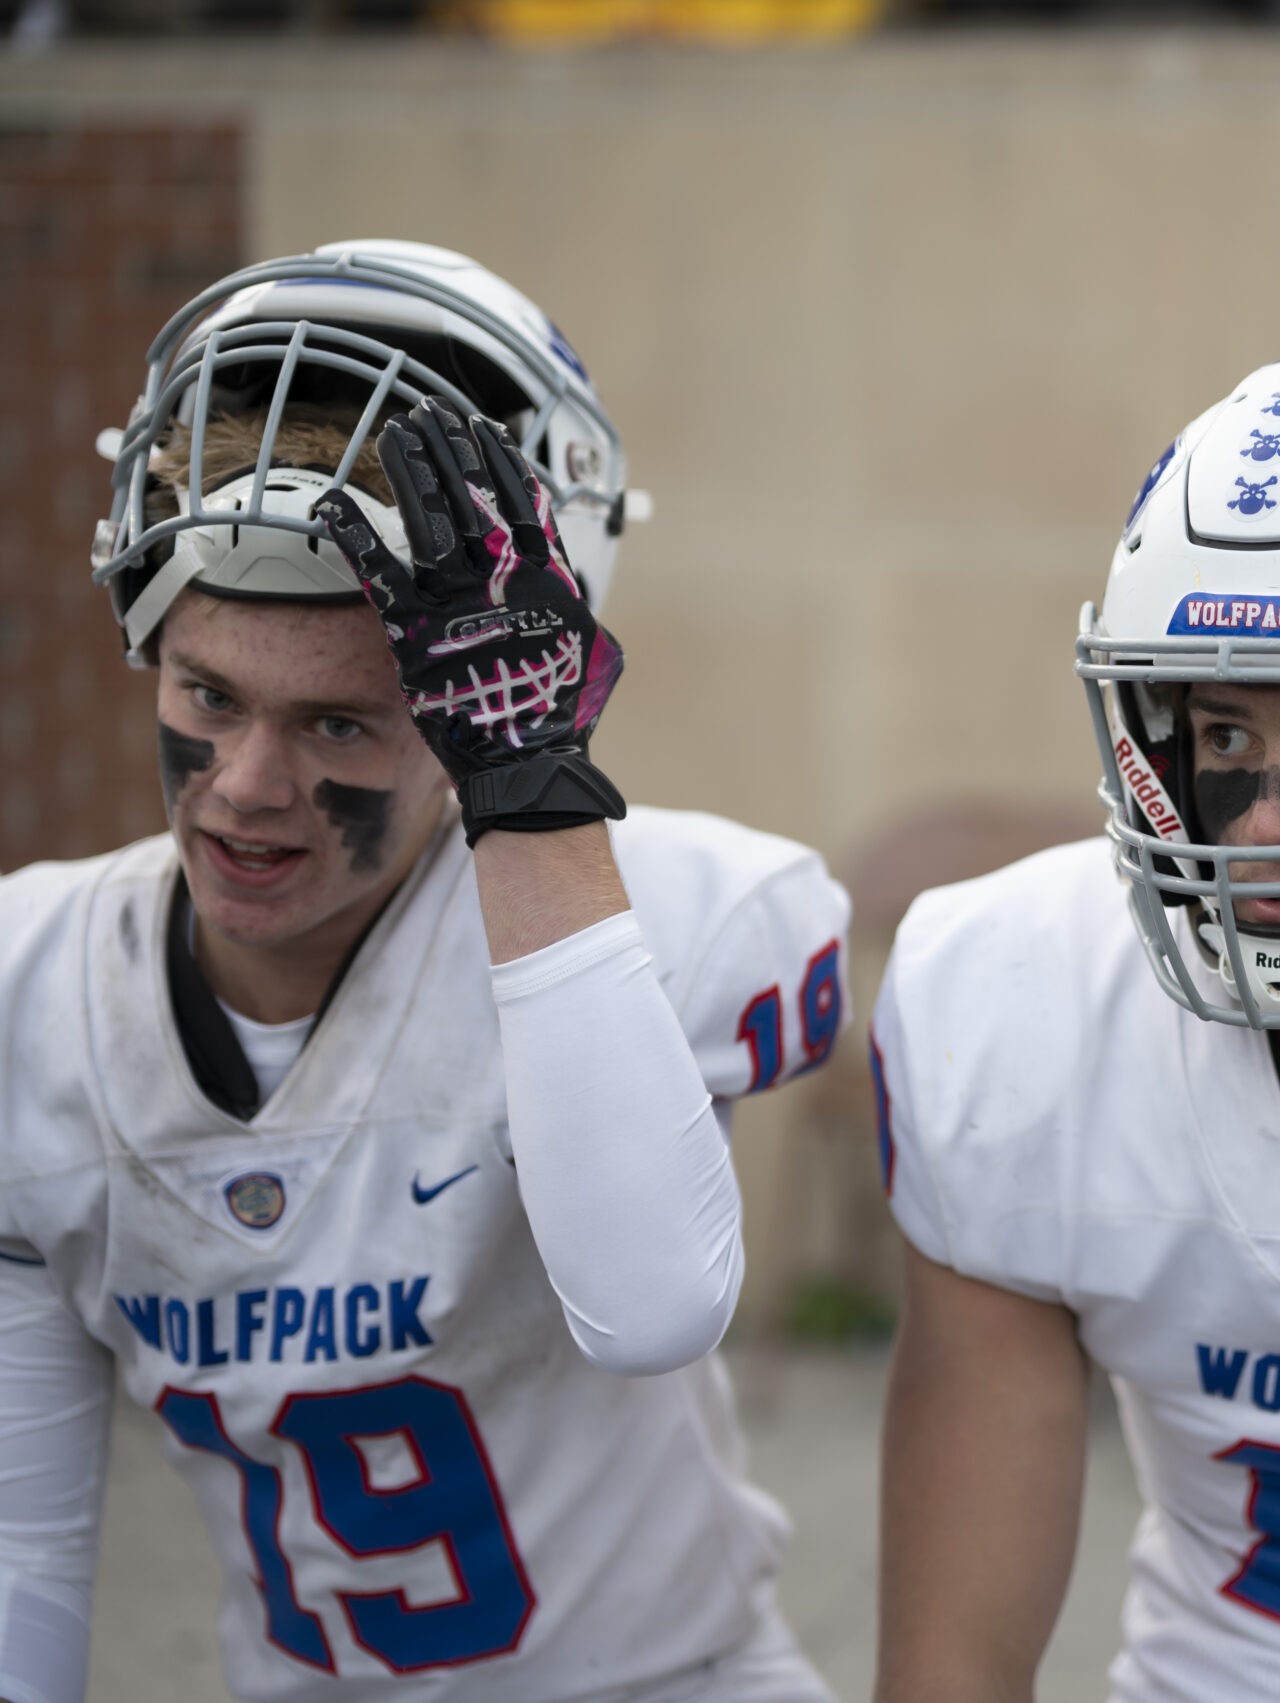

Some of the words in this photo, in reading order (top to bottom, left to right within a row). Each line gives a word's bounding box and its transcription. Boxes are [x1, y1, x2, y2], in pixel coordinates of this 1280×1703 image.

[1115, 737, 1183, 835] Riddell
[734, 936, 843, 1095] 19
[114, 1276, 435, 1368] WOLFPACK
[153, 1374, 537, 1678] 19
